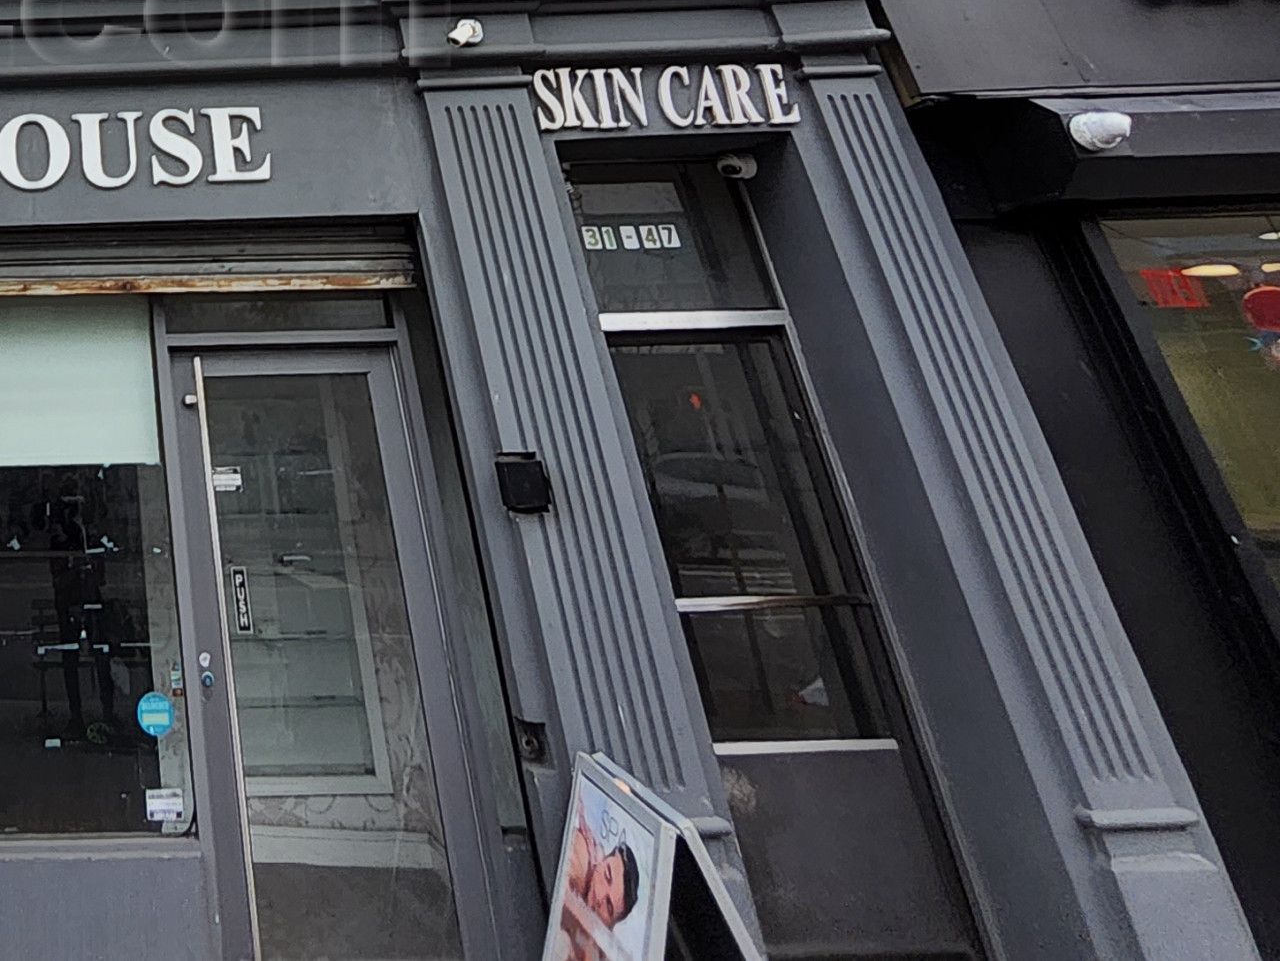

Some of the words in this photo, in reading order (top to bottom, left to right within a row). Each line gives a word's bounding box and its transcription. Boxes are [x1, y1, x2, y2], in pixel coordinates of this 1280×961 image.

[532, 67, 648, 130] SKIN
[658, 63, 802, 128] CARE
[235, 573, 249, 627] PUSH
